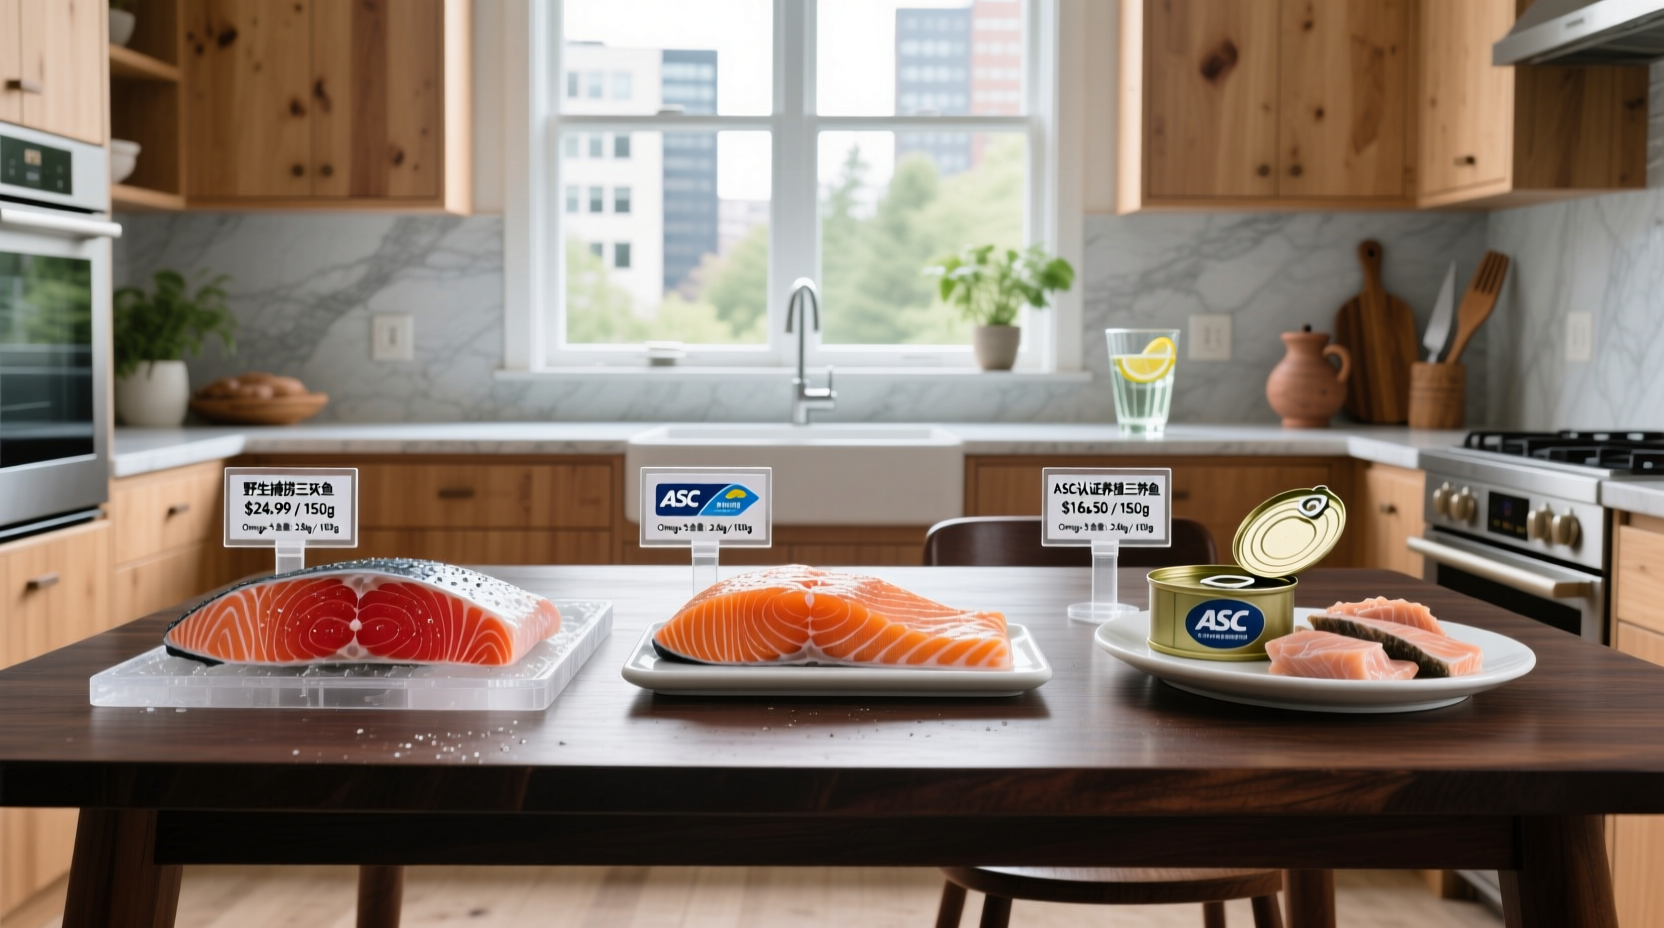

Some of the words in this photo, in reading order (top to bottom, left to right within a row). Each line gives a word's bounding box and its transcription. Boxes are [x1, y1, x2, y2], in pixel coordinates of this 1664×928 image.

[660, 490, 700, 508] ASC
[244, 501, 291, 516] $24.99
[294, 502, 301, 517] /
[304, 502, 335, 518] 150g
[1111, 502, 1118, 516] /
[1120, 502, 1150, 518] 150g
[1195, 609, 1249, 631] ASC
